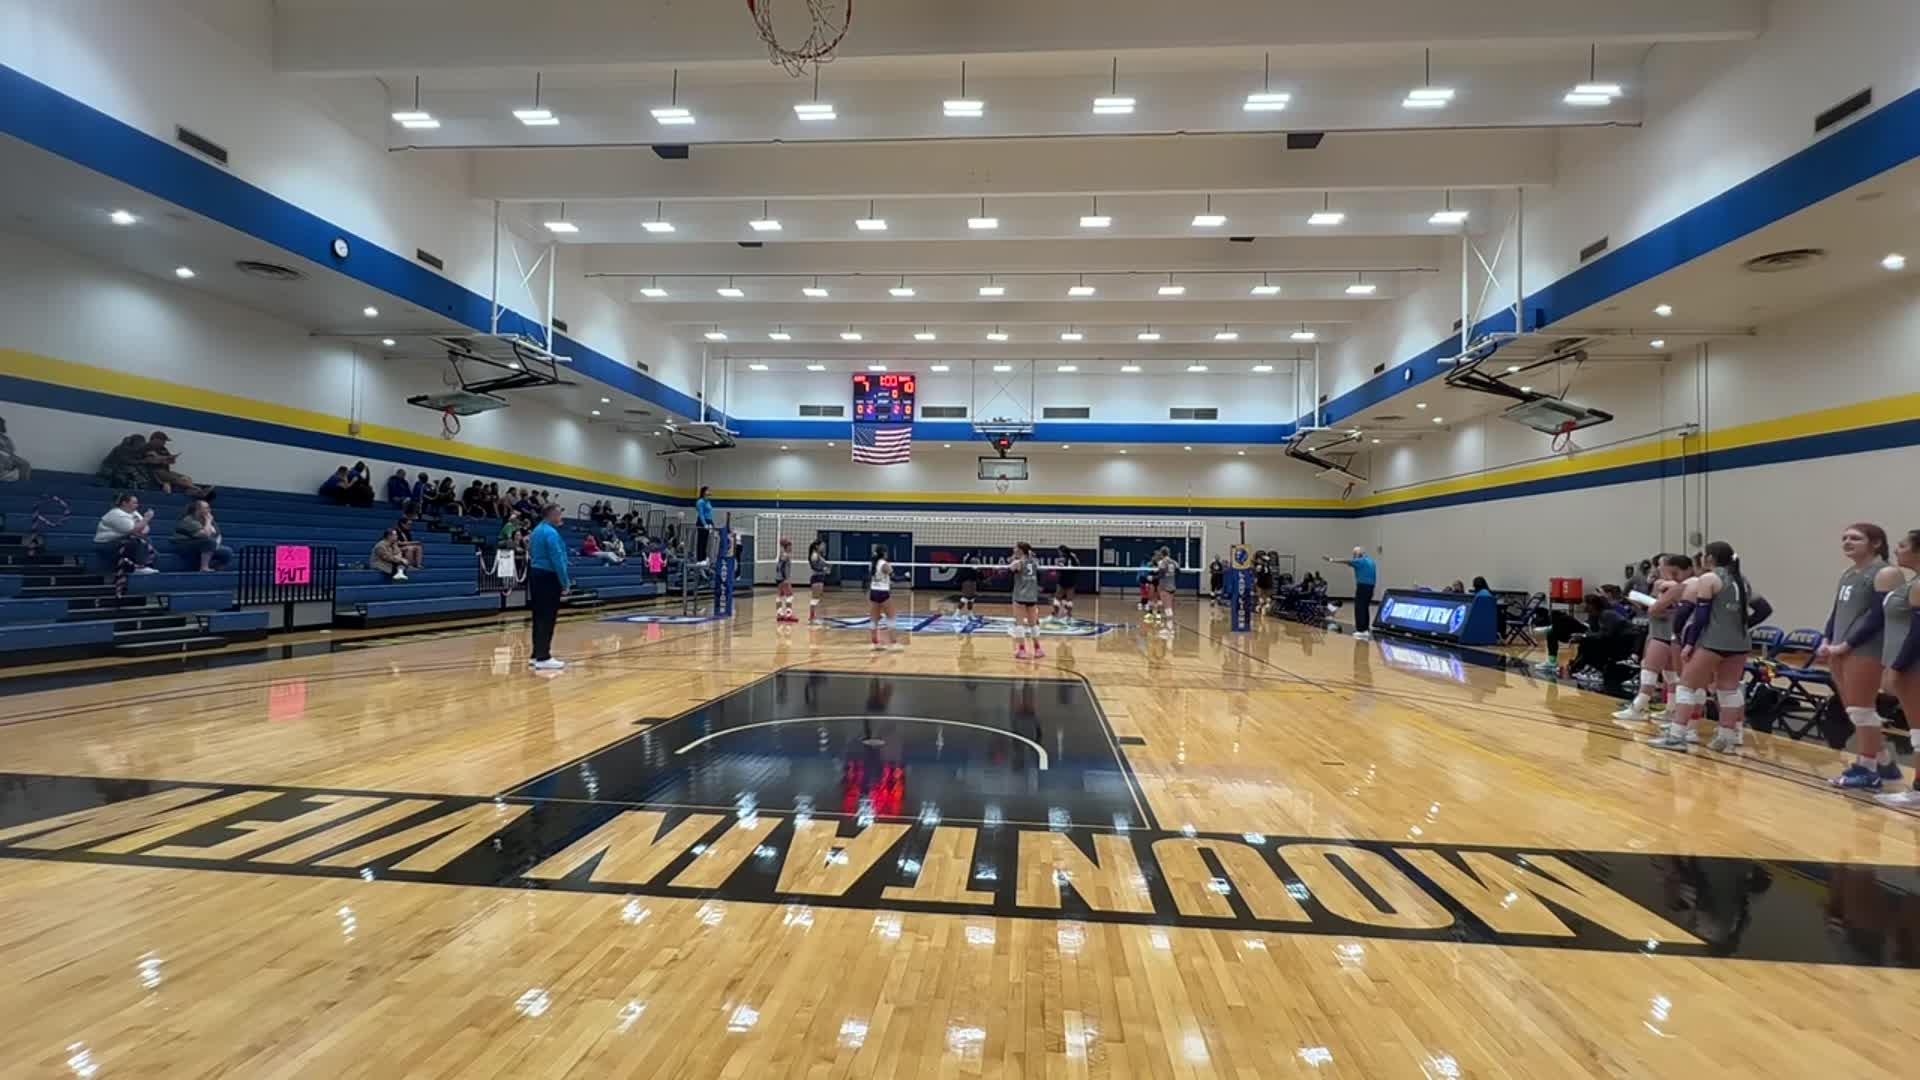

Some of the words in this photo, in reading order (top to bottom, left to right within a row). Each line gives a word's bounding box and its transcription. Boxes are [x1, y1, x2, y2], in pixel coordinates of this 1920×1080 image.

[1427, 607, 1453, 624] VIEW
[1839, 585, 1853, 601] 15
[0, 786, 534, 873] VIEW
[521, 810, 1707, 945] MOUNTAIN
